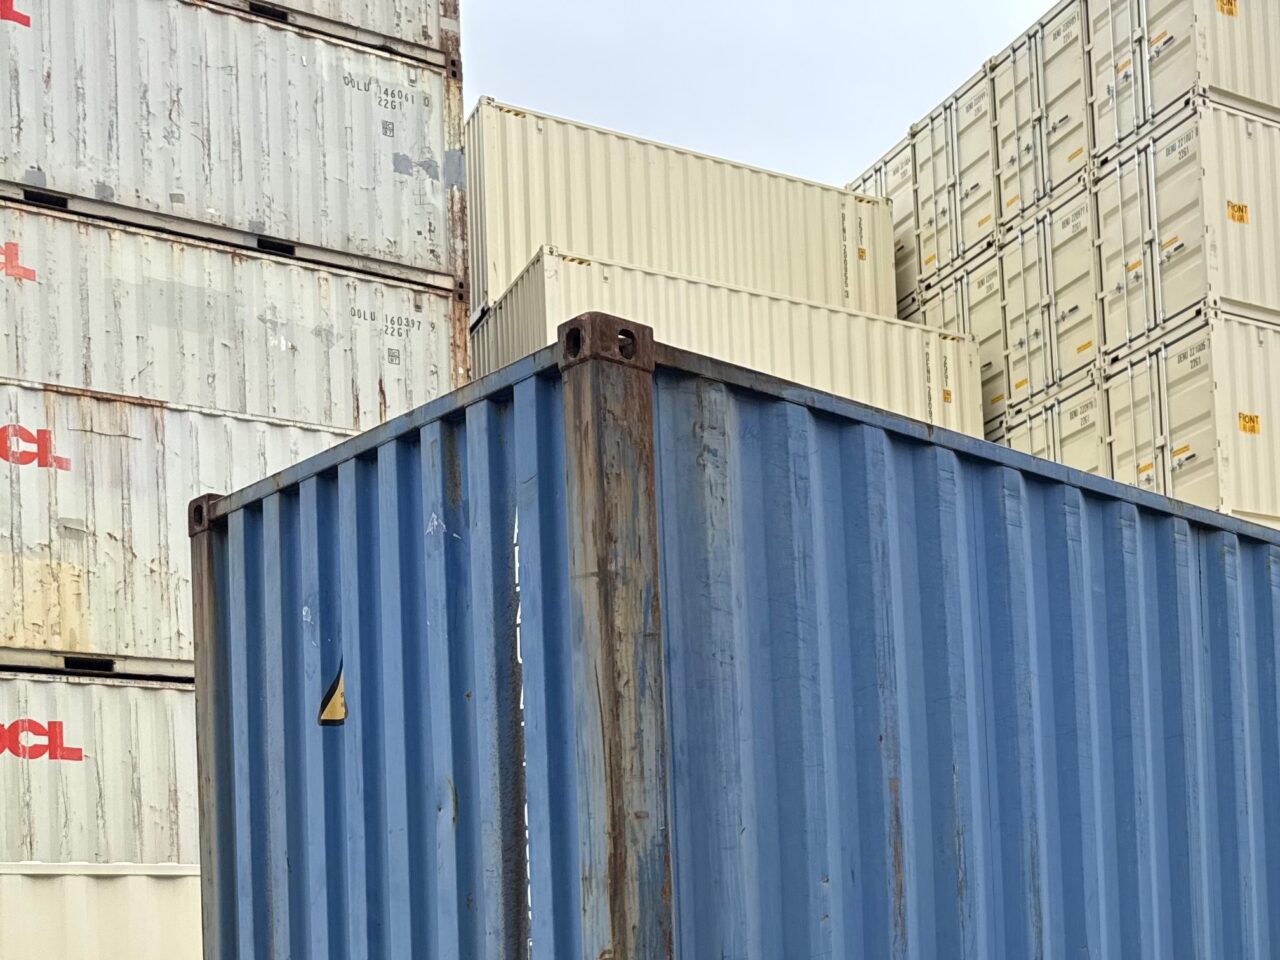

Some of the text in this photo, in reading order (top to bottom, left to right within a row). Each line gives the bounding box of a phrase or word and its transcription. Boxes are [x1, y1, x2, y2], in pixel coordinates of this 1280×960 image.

[343, 73, 372, 92] OOLU
[377, 96, 403, 110] 22G1
[350, 307, 436, 332] OOLU 160397 9
[384, 324, 409, 338] 22G1
[0, 718, 83, 761] CL
